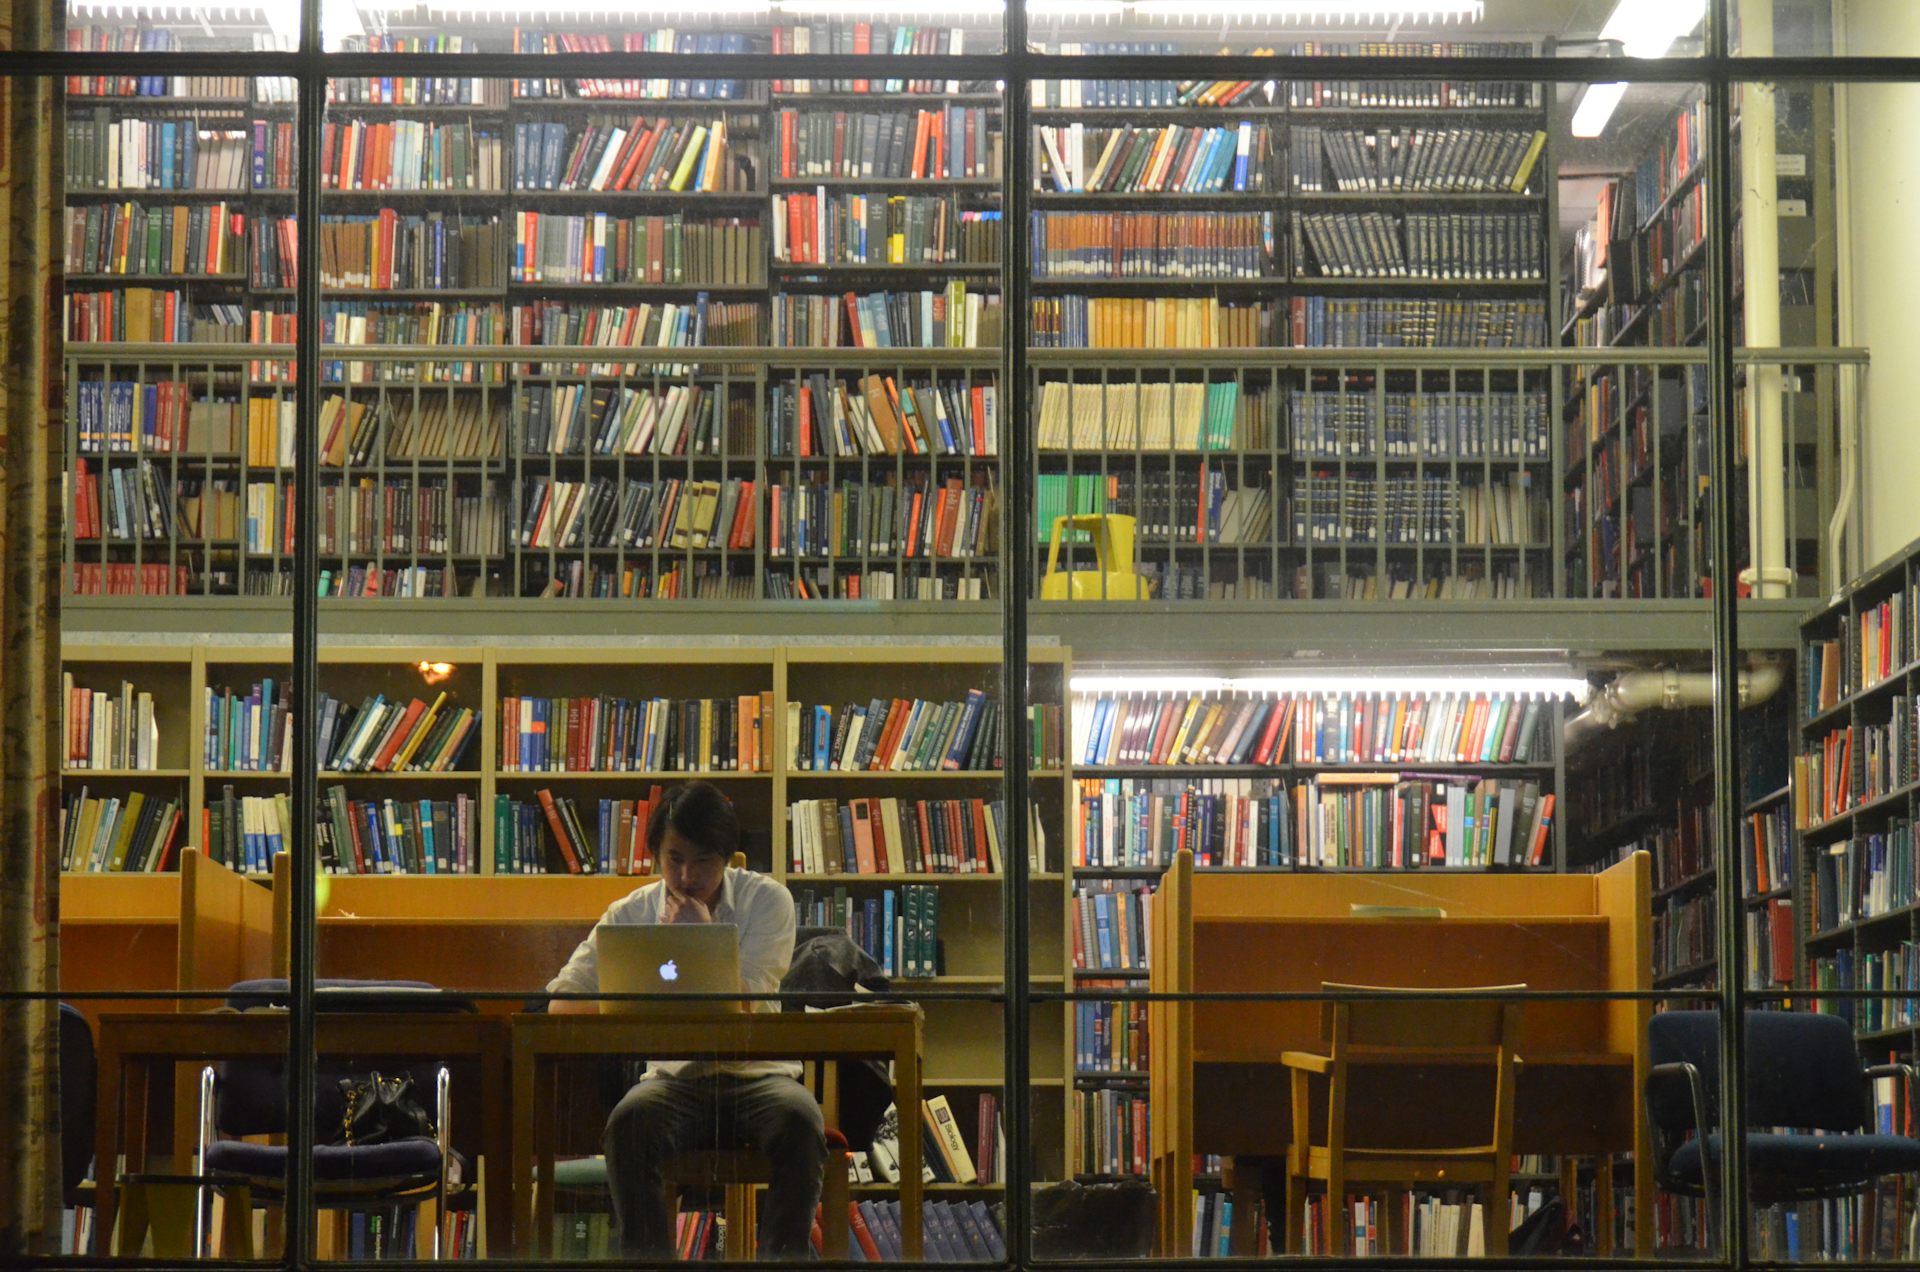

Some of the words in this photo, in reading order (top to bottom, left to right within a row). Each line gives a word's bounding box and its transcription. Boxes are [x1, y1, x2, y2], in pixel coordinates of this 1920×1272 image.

[909, 892, 917, 925] LIFE
[926, 892, 935, 925] LIFE
[944, 1124, 960, 1151] Biology
[715, 1226, 727, 1251] Biology
